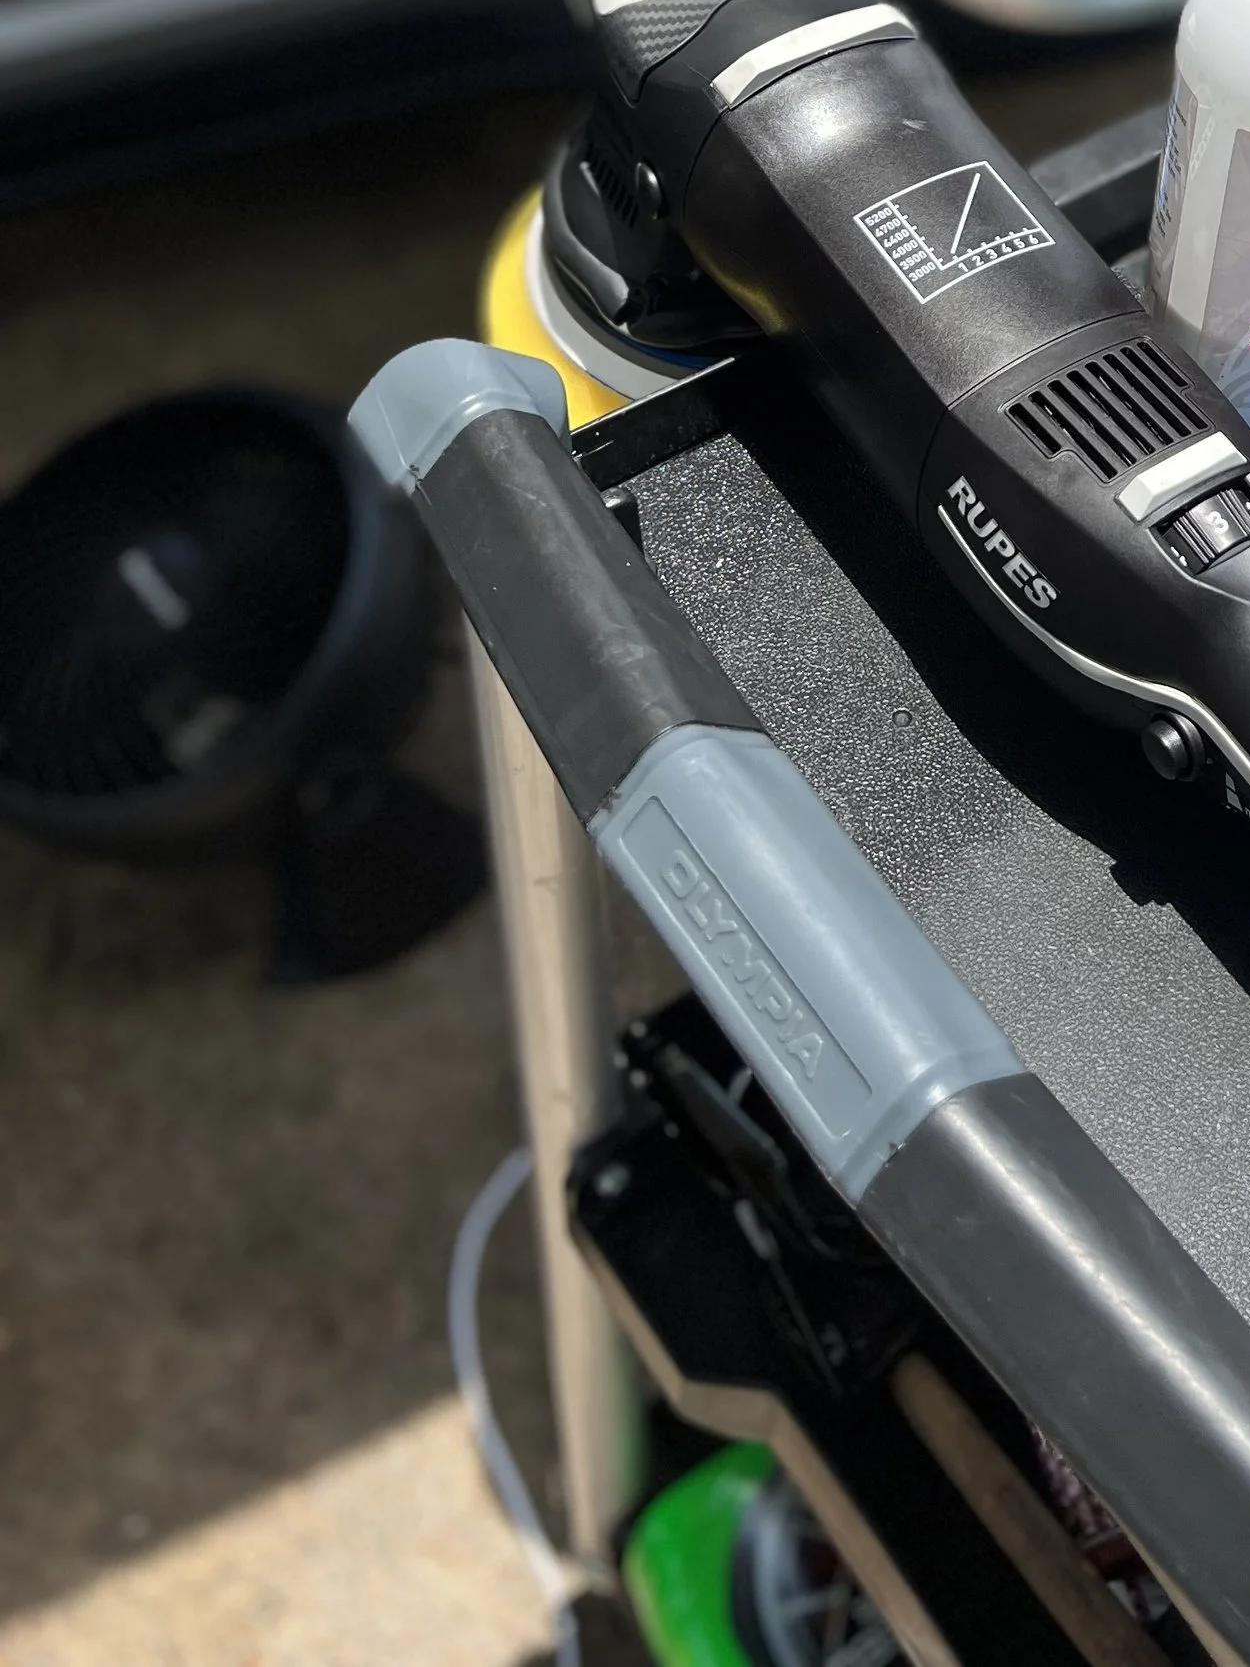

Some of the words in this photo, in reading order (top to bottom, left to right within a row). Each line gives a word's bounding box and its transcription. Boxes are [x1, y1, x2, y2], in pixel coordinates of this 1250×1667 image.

[864, 207, 893, 227] 5200
[875, 218, 902, 238] 4700
[883, 228, 910, 249] 4400
[891, 239, 919, 260] 4000
[958, 262, 969, 273] 1
[972, 255, 985, 266] 2
[985, 248, 998, 260] 3
[1001, 243, 1012, 254] 4
[1013, 238, 1025, 249] 5
[1029, 234, 1039, 245] 6
[899, 250, 928, 271] 3500
[908, 261, 937, 283] 3000
[1204, 509, 1230, 535] 3
[947, 475, 1058, 609] RUPES
[661, 848, 824, 1079] OLYMPIA
